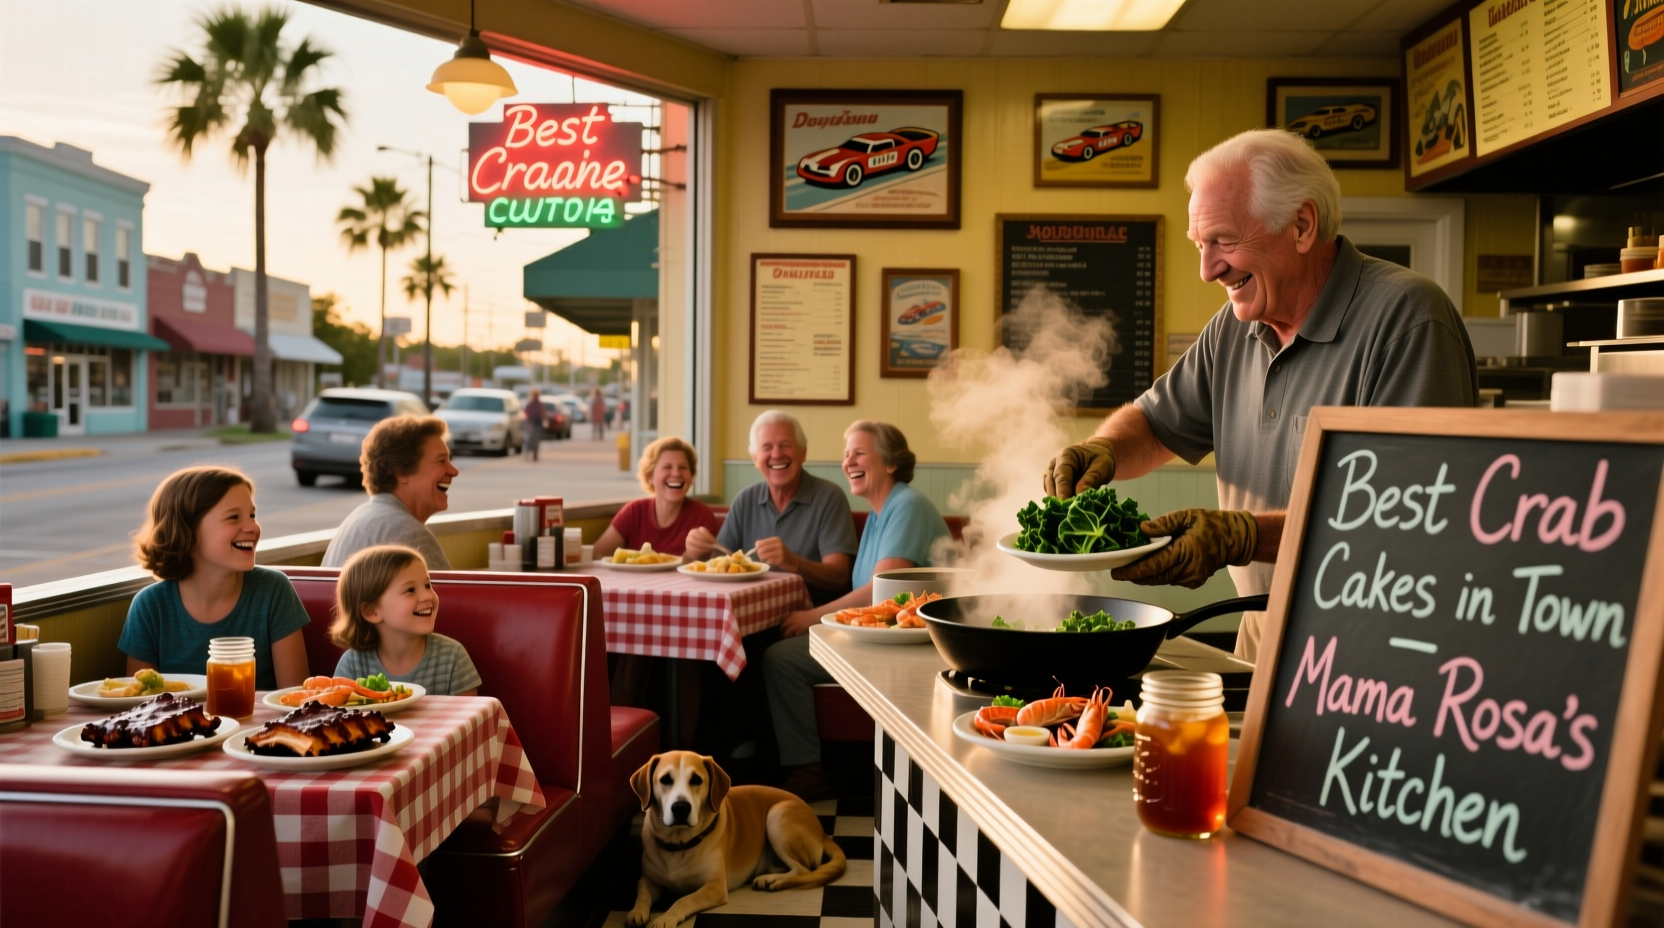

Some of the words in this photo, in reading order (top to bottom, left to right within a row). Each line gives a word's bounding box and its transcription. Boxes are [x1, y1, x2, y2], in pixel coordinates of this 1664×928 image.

[505, 104, 606, 148] Best
[1327, 449, 1456, 534] Best
[1469, 454, 1626, 552] Crab
[1313, 541, 1437, 618] Cakes
[1455, 573, 1495, 625] in
[1513, 564, 1626, 648] Town
[1285, 635, 1416, 727] Mama
[1433, 656, 1598, 771] Rosa's
[1319, 726, 1527, 863] Kitchen
